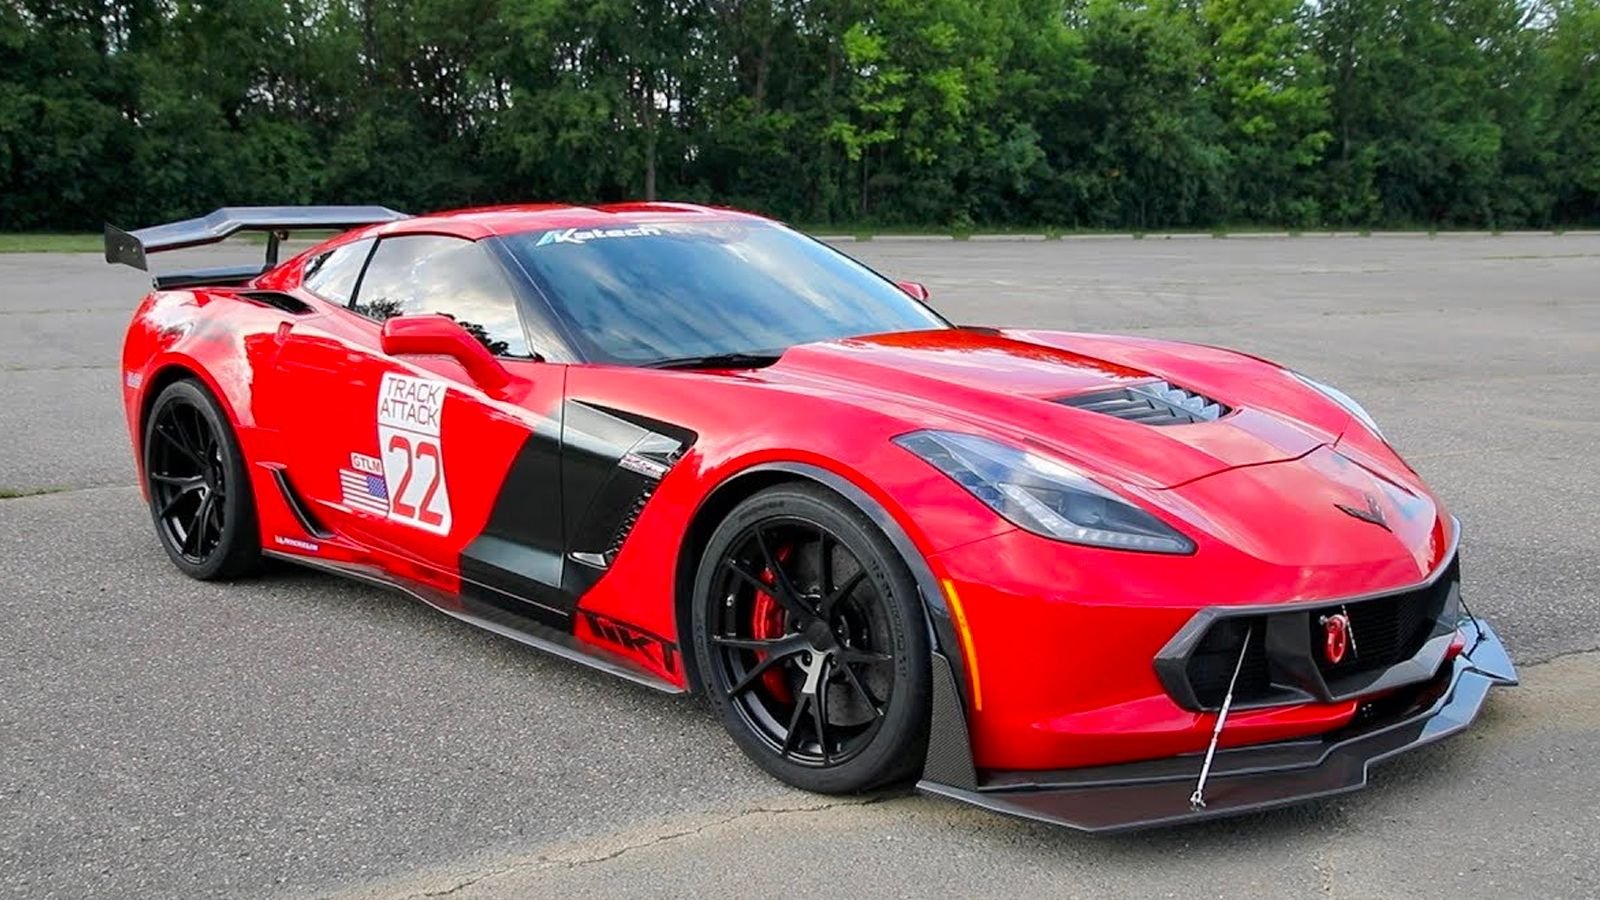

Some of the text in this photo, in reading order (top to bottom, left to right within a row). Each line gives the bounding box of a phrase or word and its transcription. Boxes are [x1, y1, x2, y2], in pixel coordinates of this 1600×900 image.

[545, 226, 661, 245] Katech
[388, 377, 441, 405] TRACK
[380, 398, 439, 428] ATTACK
[353, 455, 382, 473] GTLM
[389, 434, 443, 527] 22
